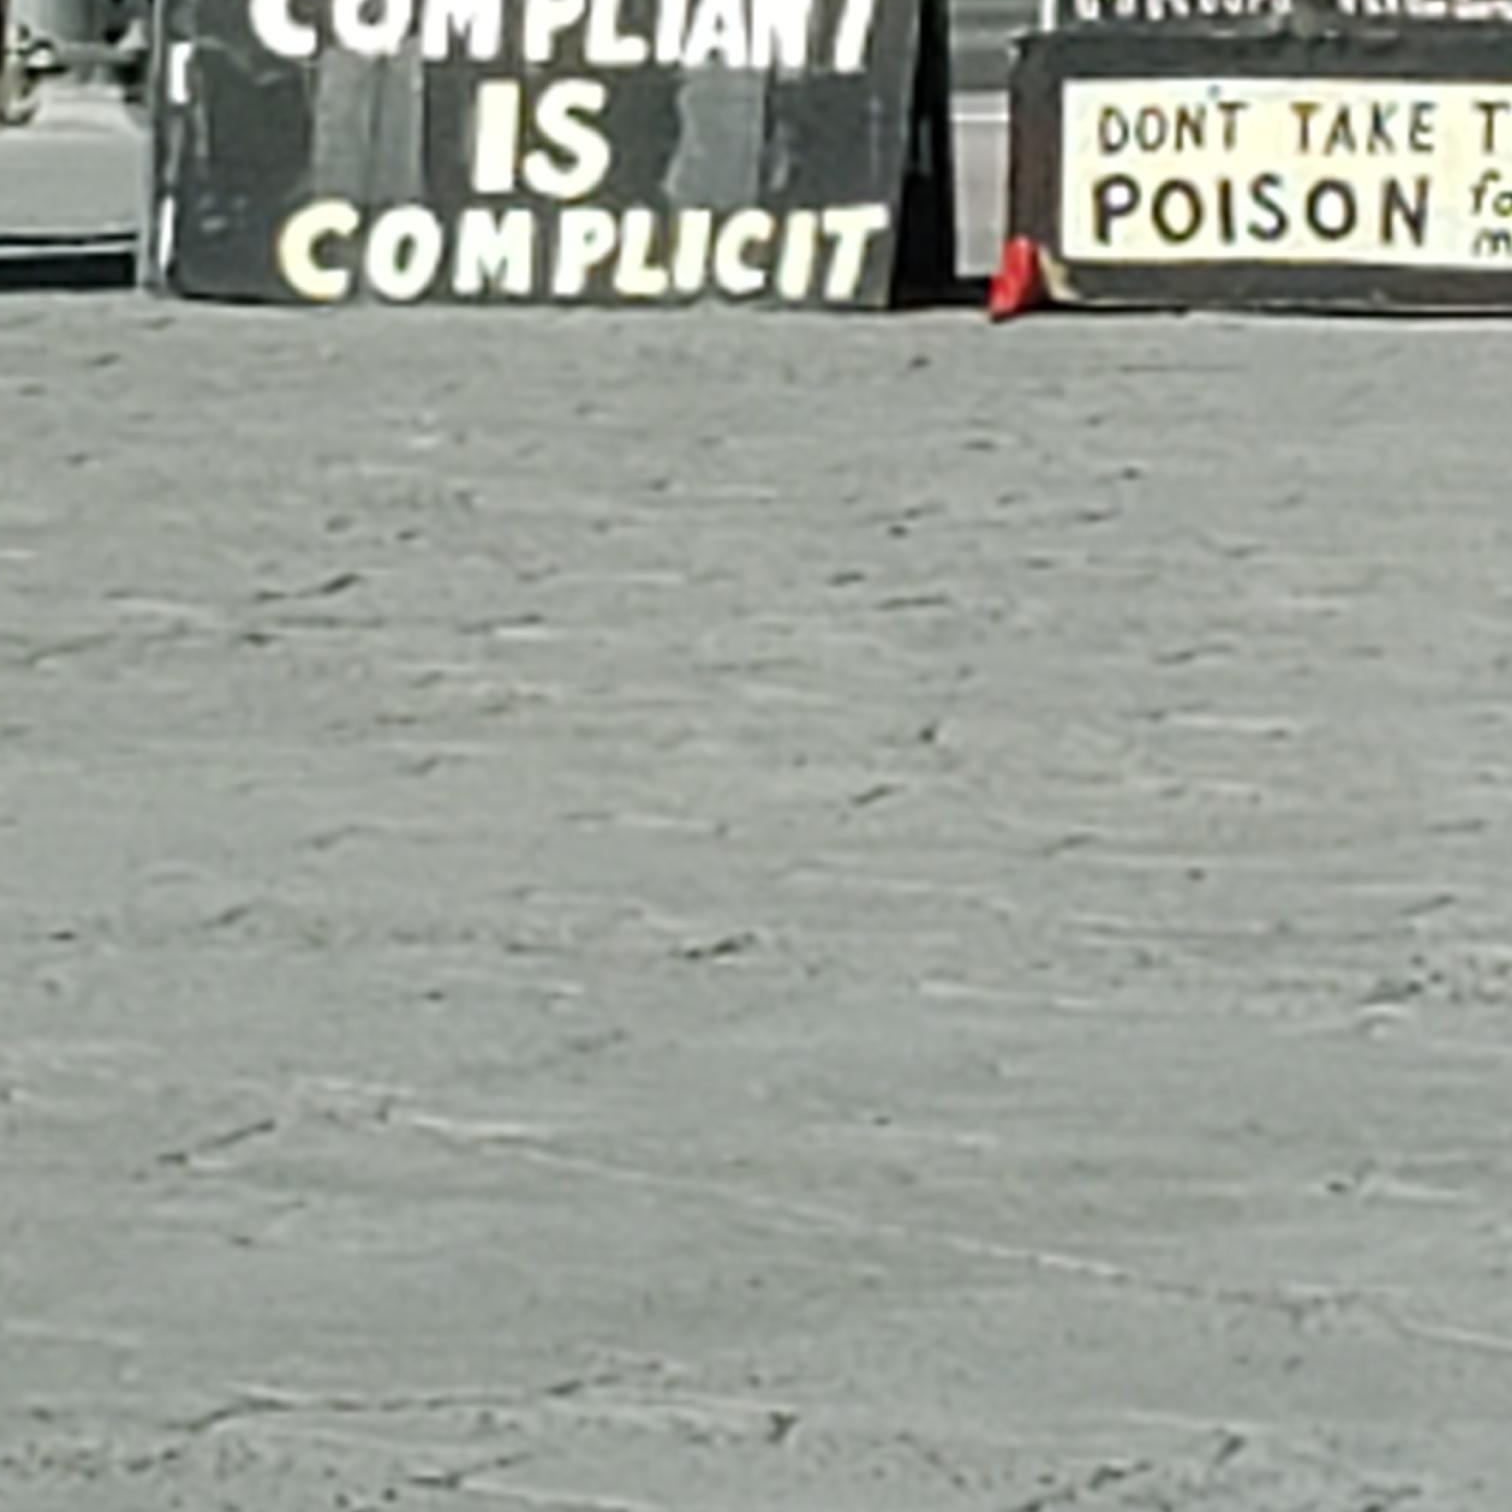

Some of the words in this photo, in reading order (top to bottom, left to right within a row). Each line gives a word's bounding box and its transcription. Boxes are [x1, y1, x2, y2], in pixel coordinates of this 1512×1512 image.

[472, 79, 612, 200] IS
[1291, 100, 1437, 155] TAKE
[277, 199, 890, 302] COMPLICIT
[1092, 173, 1430, 247] POISON
